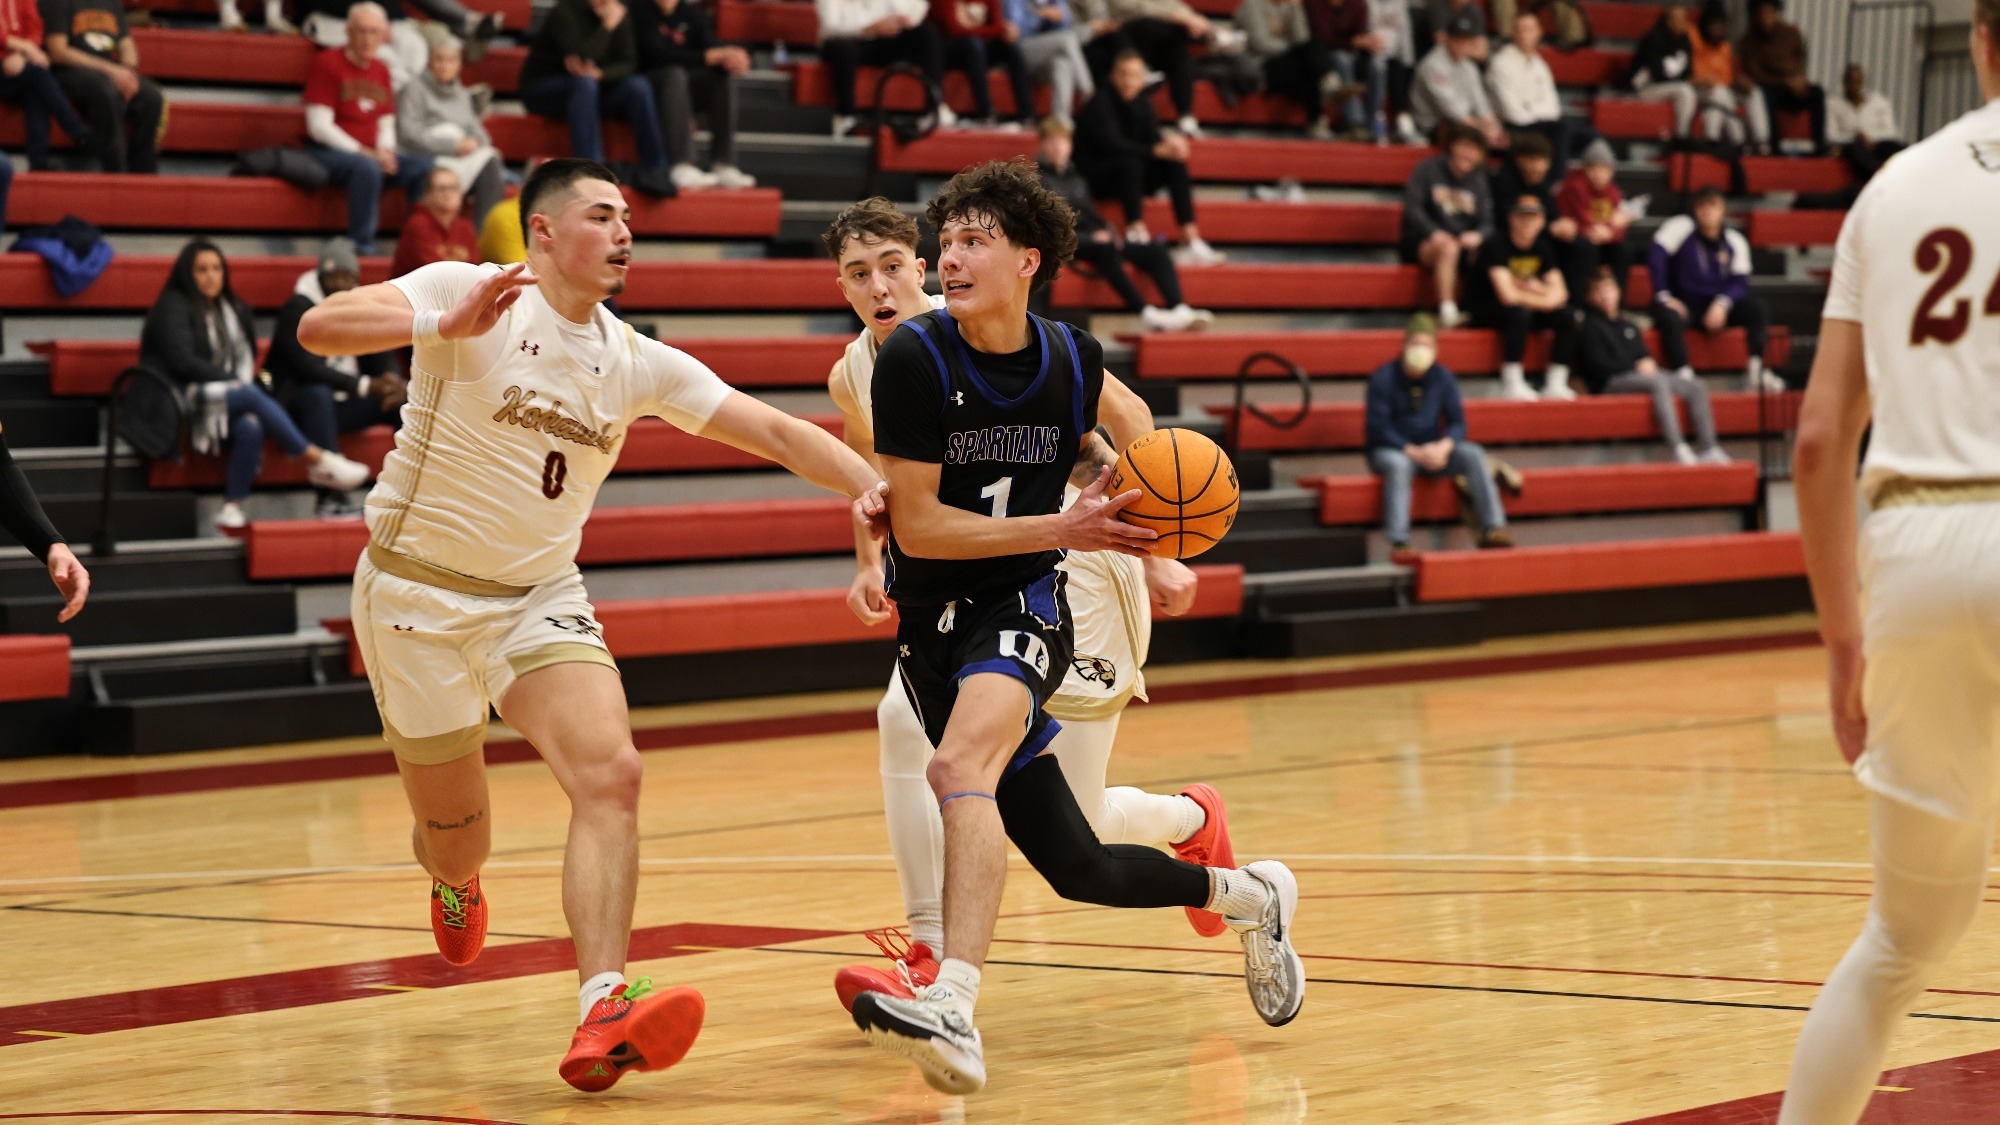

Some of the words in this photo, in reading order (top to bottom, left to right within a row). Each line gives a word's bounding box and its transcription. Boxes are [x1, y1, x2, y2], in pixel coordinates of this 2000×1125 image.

[944, 425, 1060, 465] SPARTANS
[542, 451, 568, 500] 0
[980, 476, 1013, 518] 1
